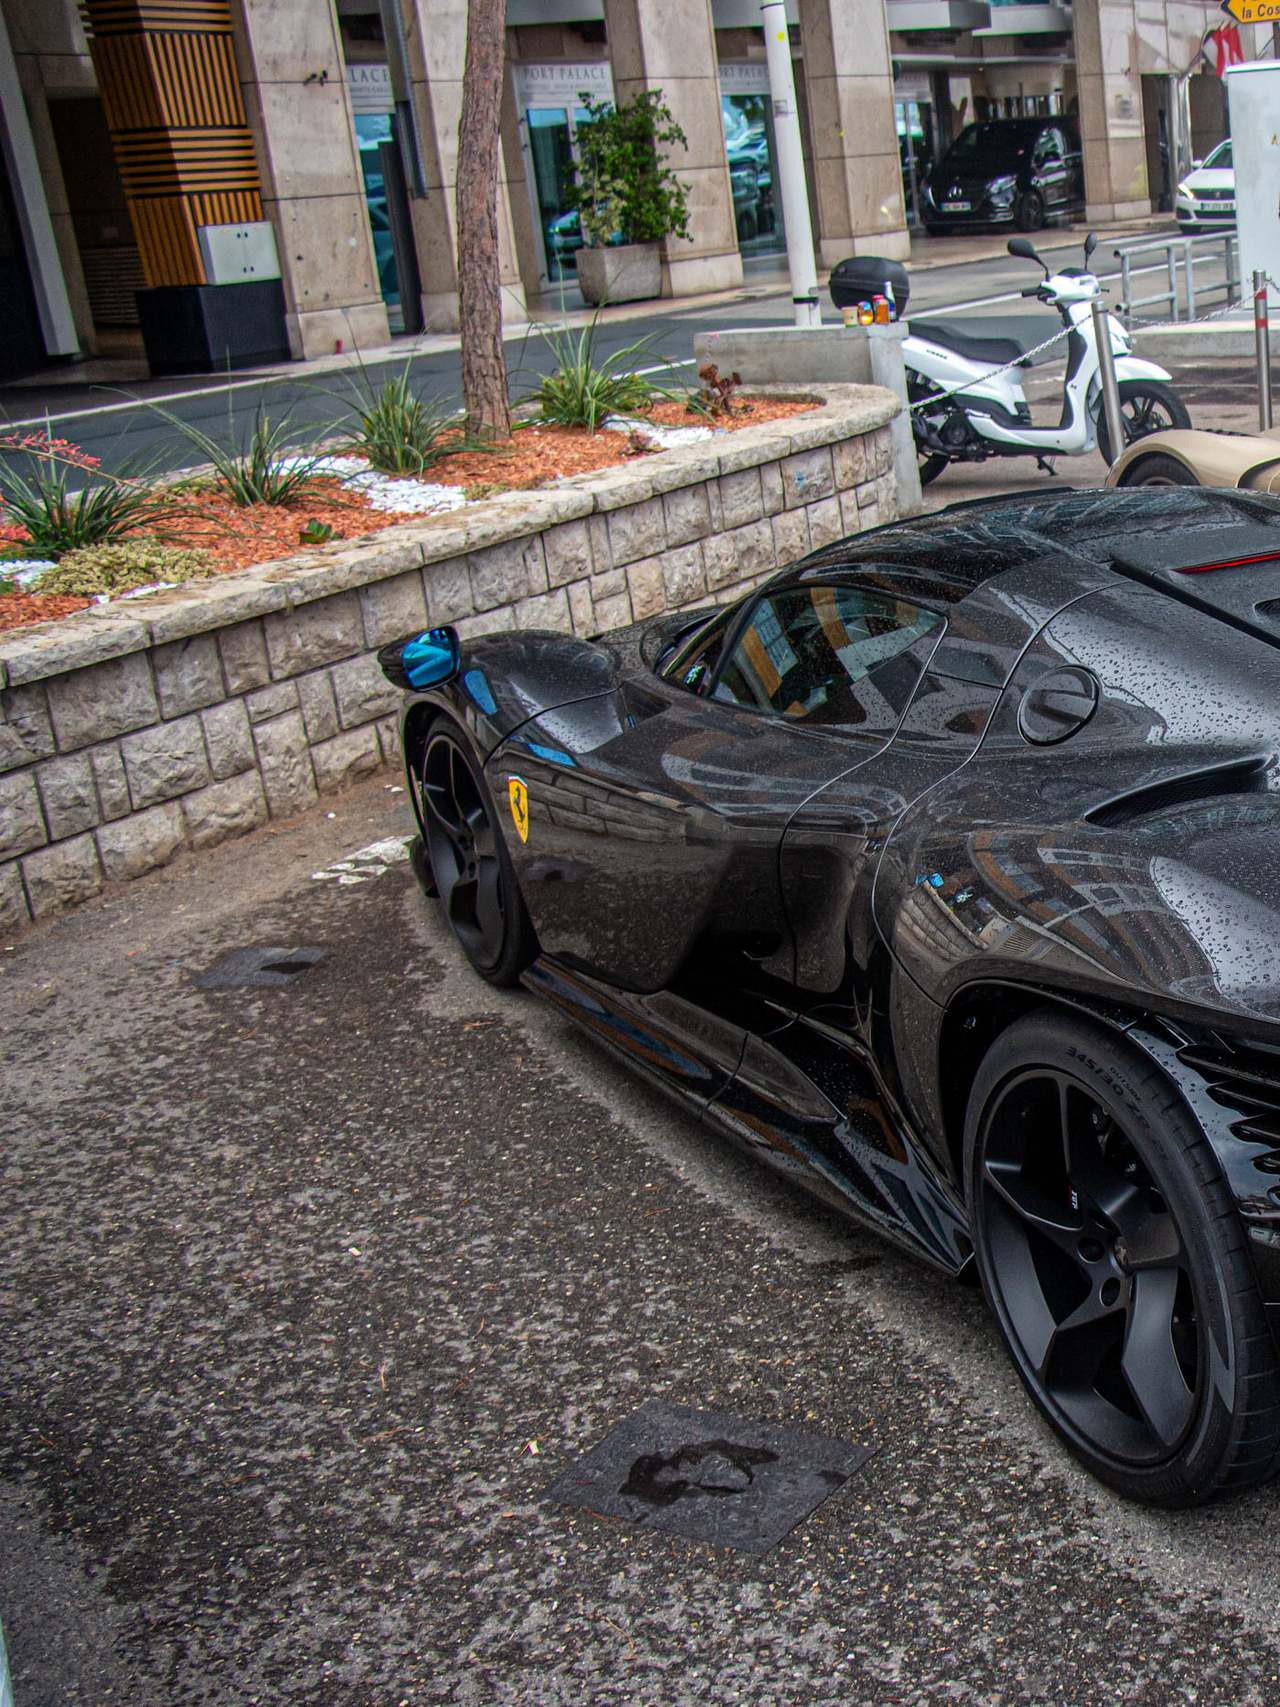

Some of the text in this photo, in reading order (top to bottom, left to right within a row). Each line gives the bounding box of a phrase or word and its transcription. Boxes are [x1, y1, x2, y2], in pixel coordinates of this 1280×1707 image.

[1241, 7, 1252, 19] la
[523, 66, 606, 80] PORT PALACE
